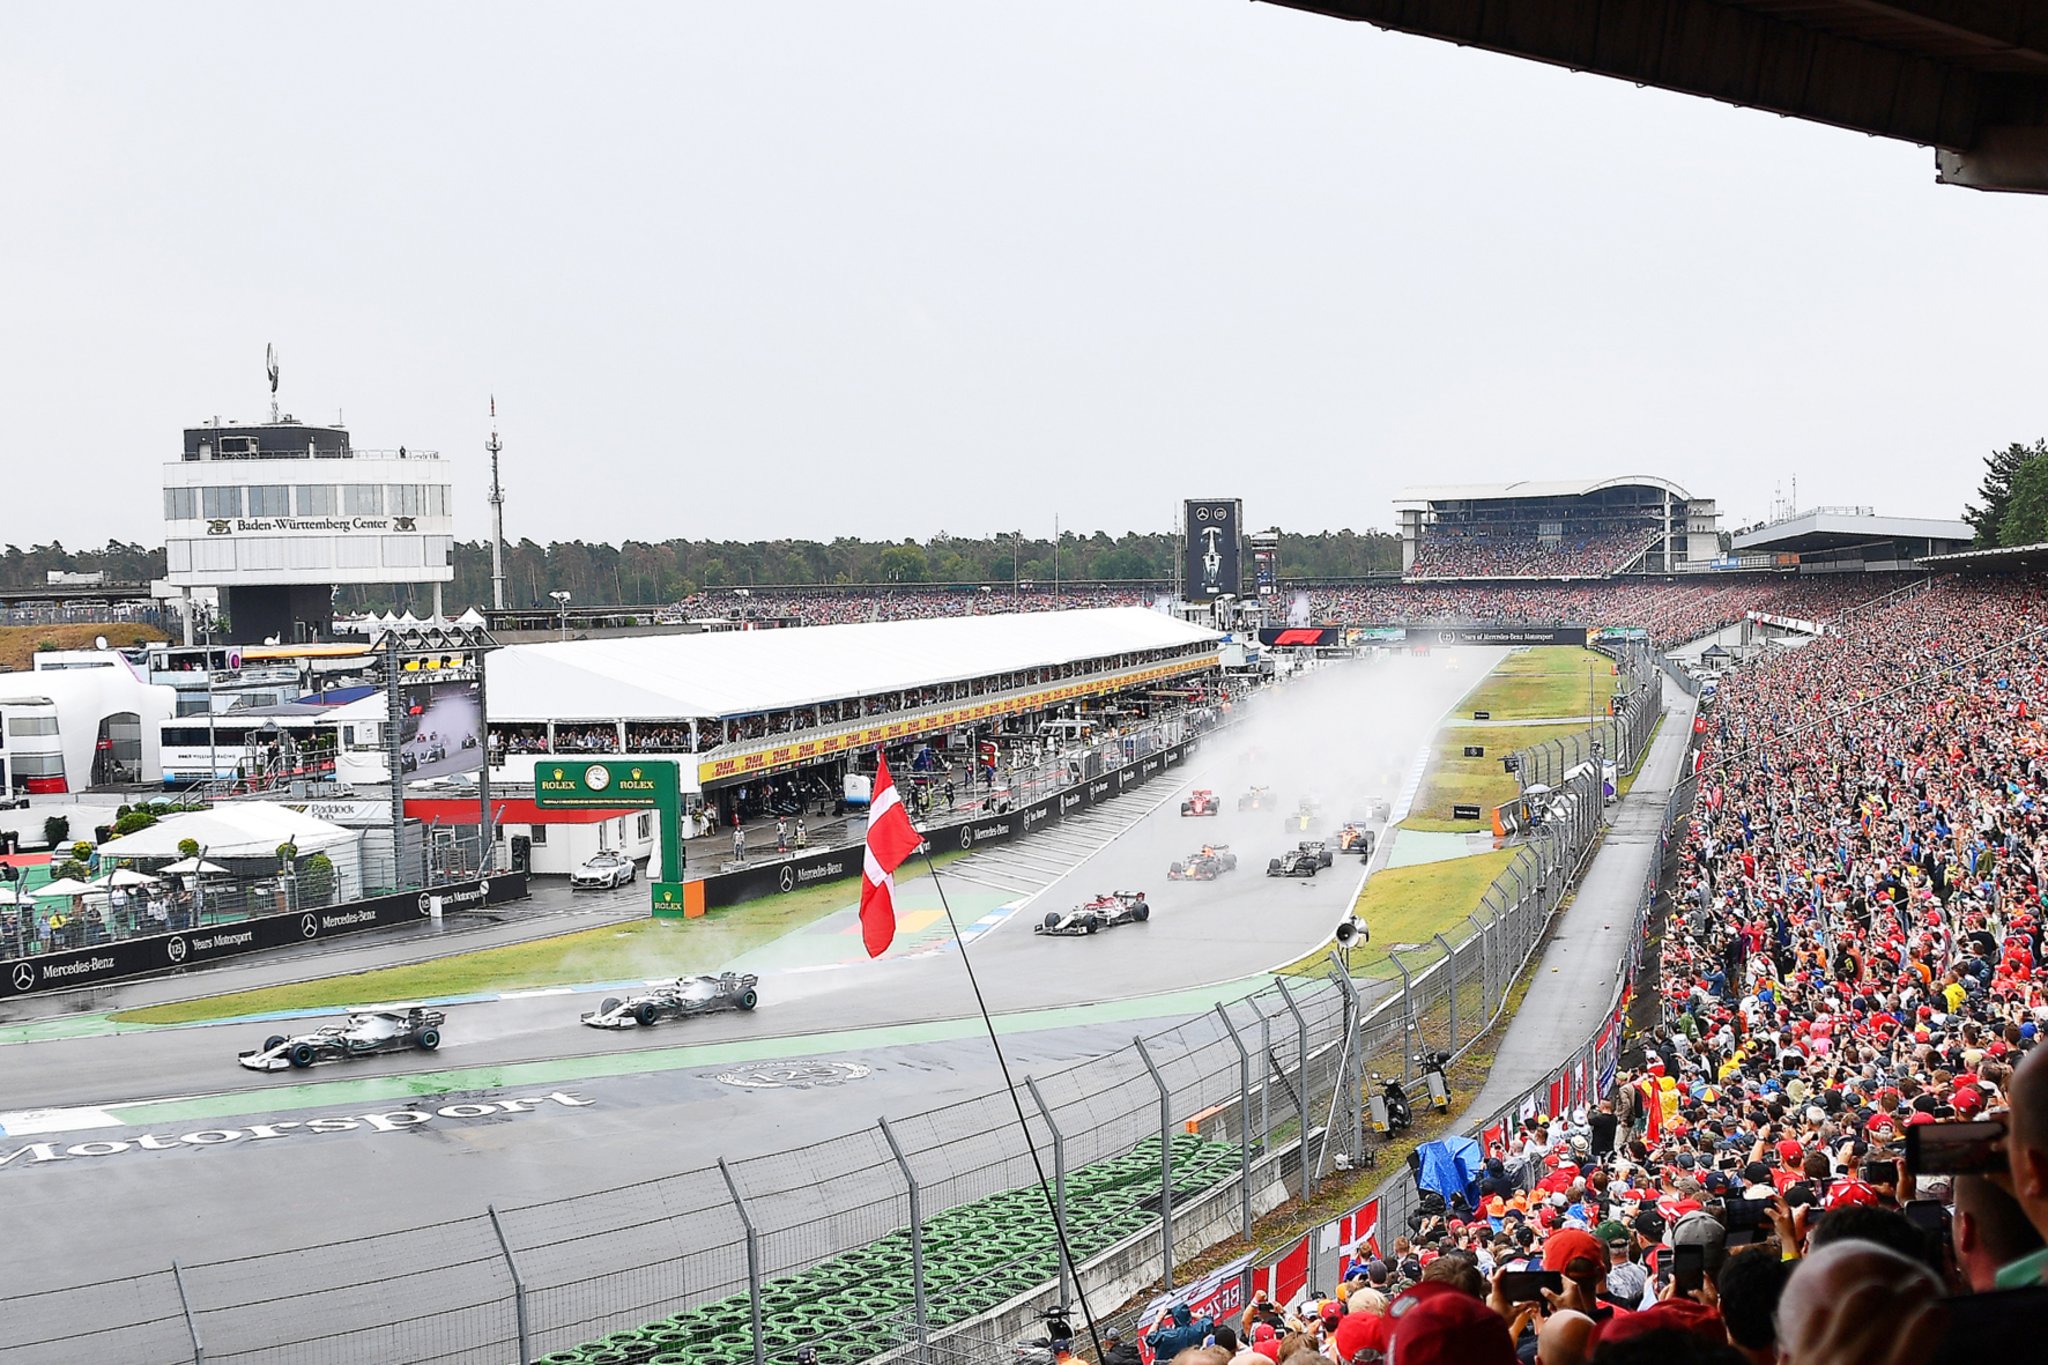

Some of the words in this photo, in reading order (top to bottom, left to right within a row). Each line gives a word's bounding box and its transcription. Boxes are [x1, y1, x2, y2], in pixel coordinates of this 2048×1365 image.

[237, 518, 350, 533] Baden-Württemberg
[352, 517, 388, 529] Center
[798, 743, 815, 758] DHL
[823, 738, 839, 751] DHL
[744, 754, 763, 770] DHL
[772, 748, 789, 763] DHL
[715, 760, 737, 776] DHL
[541, 780, 576, 790] ROLEX
[619, 780, 654, 790] ROLEX
[312, 804, 355, 814] Paddock
[798, 862, 843, 882] Mercedes-Benz
[441, 894, 454, 905] ears
[453, 889, 481, 903] Motorspor
[655, 902, 682, 910] ROLEX
[322, 910, 377, 929] Mercedes-Benz
[171, 943, 183, 956] 125
[192, 937, 213, 951] Years
[213, 931, 253, 949] Motorsport
[43, 957, 115, 979] Mercedes-Benz
